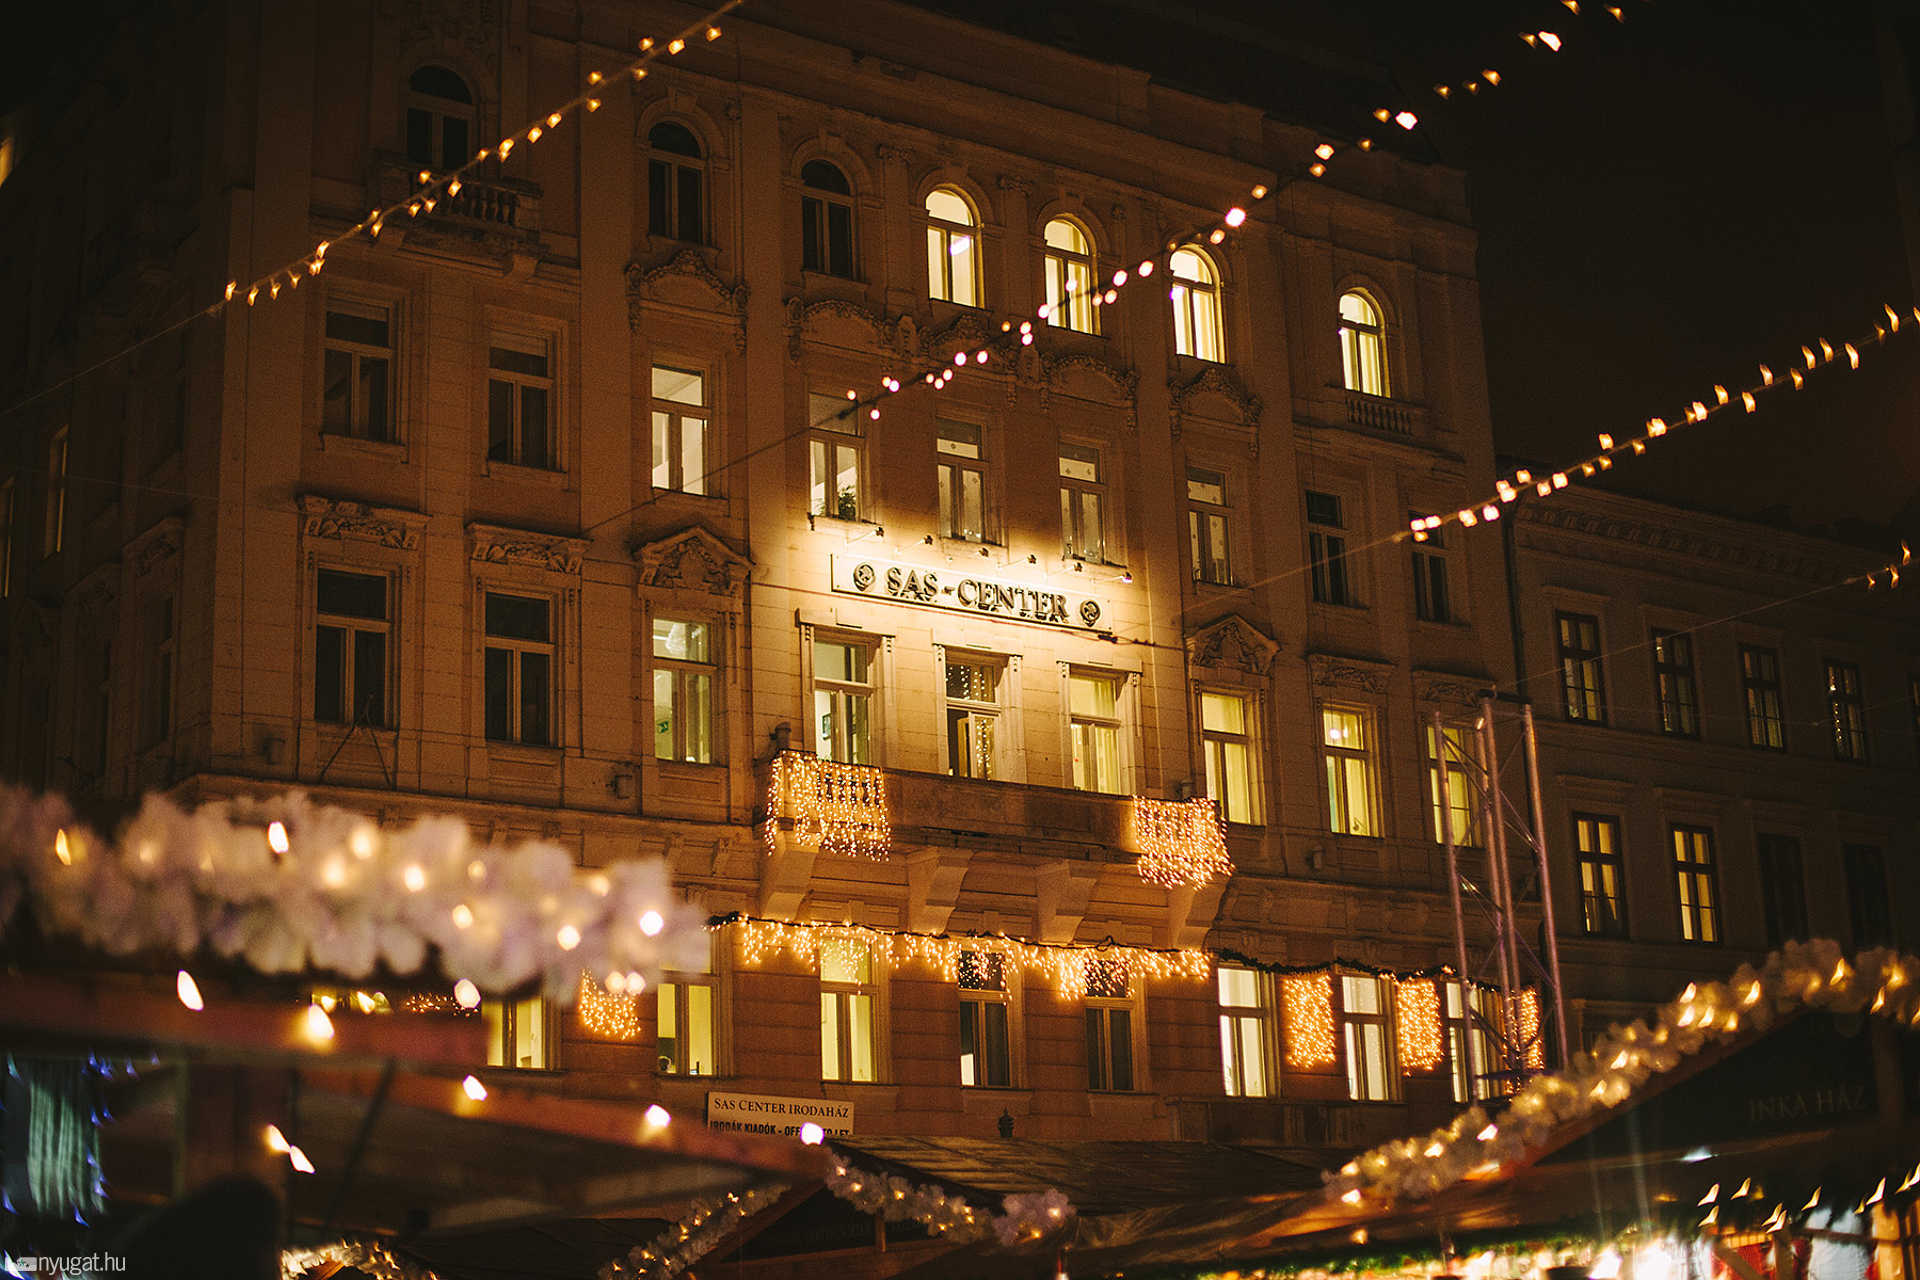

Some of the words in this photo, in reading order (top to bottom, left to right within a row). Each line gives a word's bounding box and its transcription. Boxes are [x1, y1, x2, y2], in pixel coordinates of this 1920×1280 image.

[714, 1098, 736, 1110] SAS
[738, 1099, 786, 1114] CENTER
[788, 1104, 849, 1119] IRODAHÁZ
[744, 1122, 776, 1135] KIADÓK
